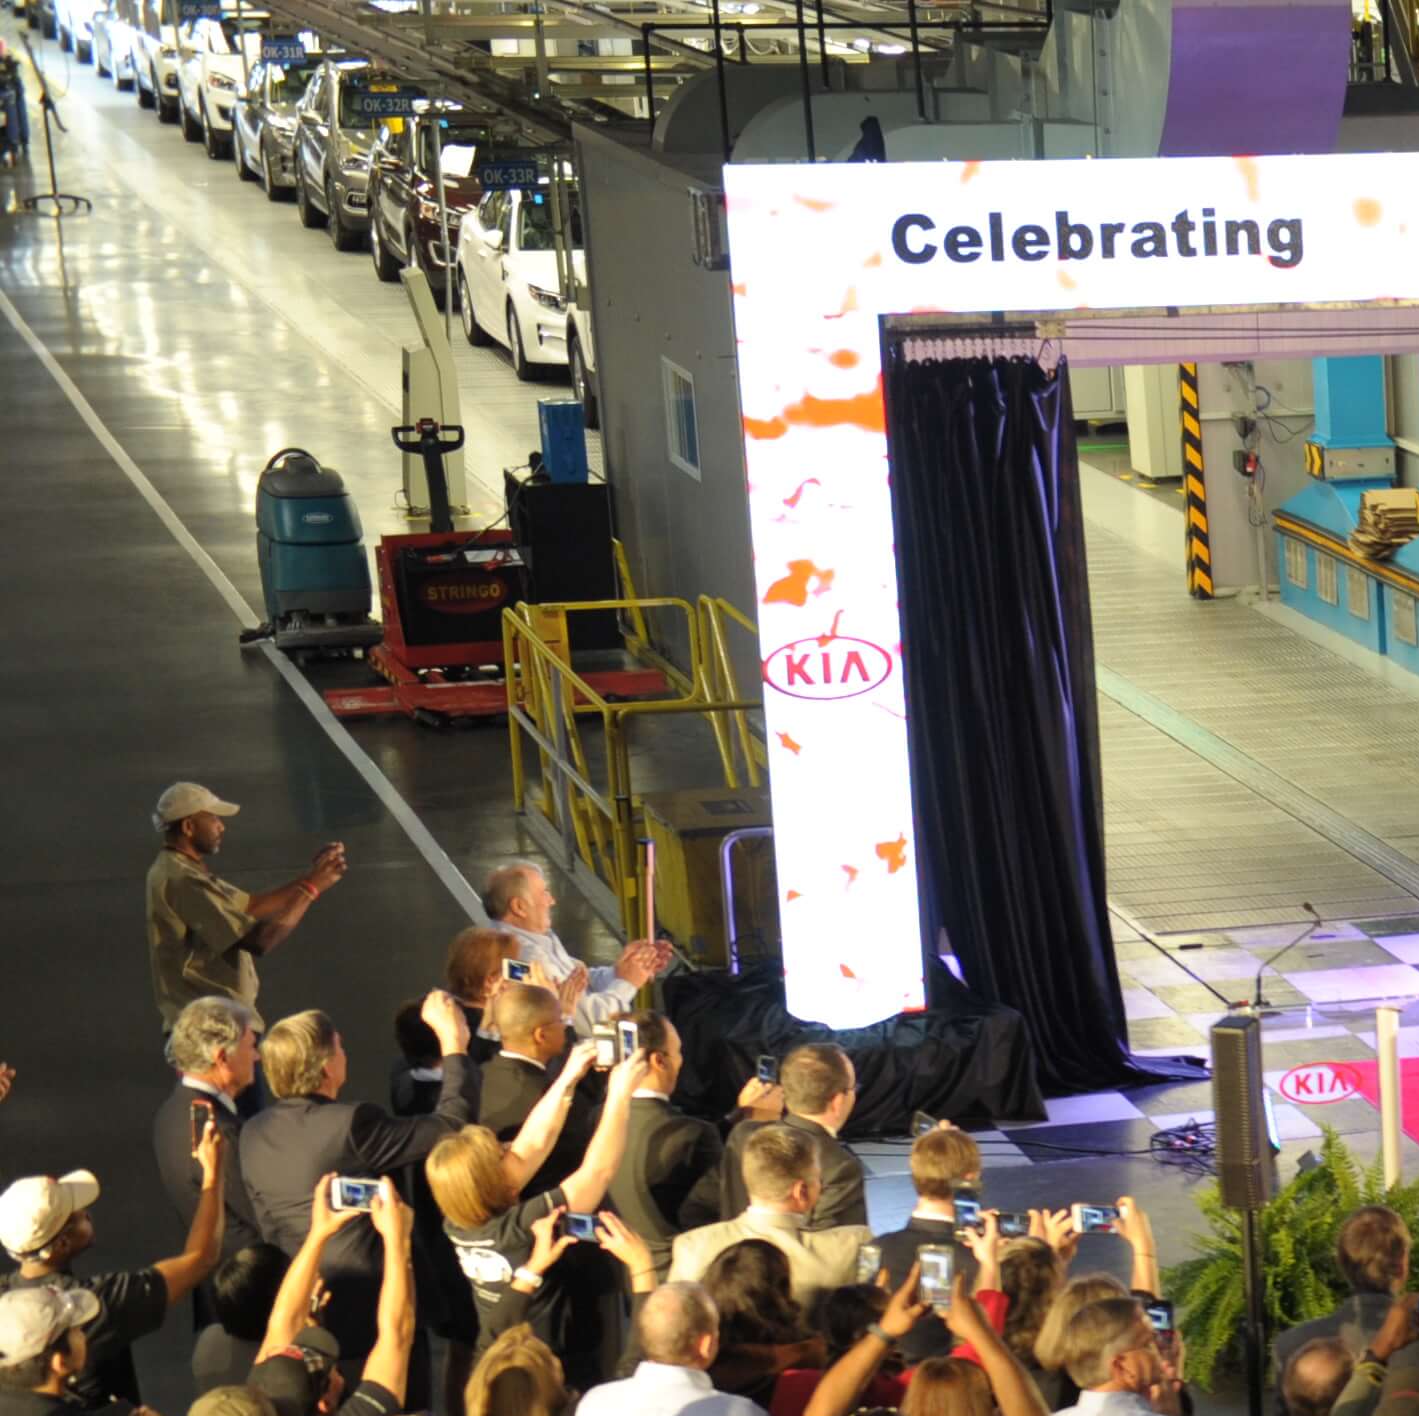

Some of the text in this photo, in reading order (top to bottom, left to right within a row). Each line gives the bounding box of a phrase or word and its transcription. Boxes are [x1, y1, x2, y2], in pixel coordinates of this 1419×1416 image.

[262, 46, 306, 60] OK-31R
[363, 98, 413, 113] OK-32R
[483, 168, 537, 185] OK-33R
[891, 207, 1304, 269] Celebrating
[426, 583, 502, 601] STRINGO
[785, 651, 871, 687] KIA
[1295, 1072, 1348, 1096] KIA
